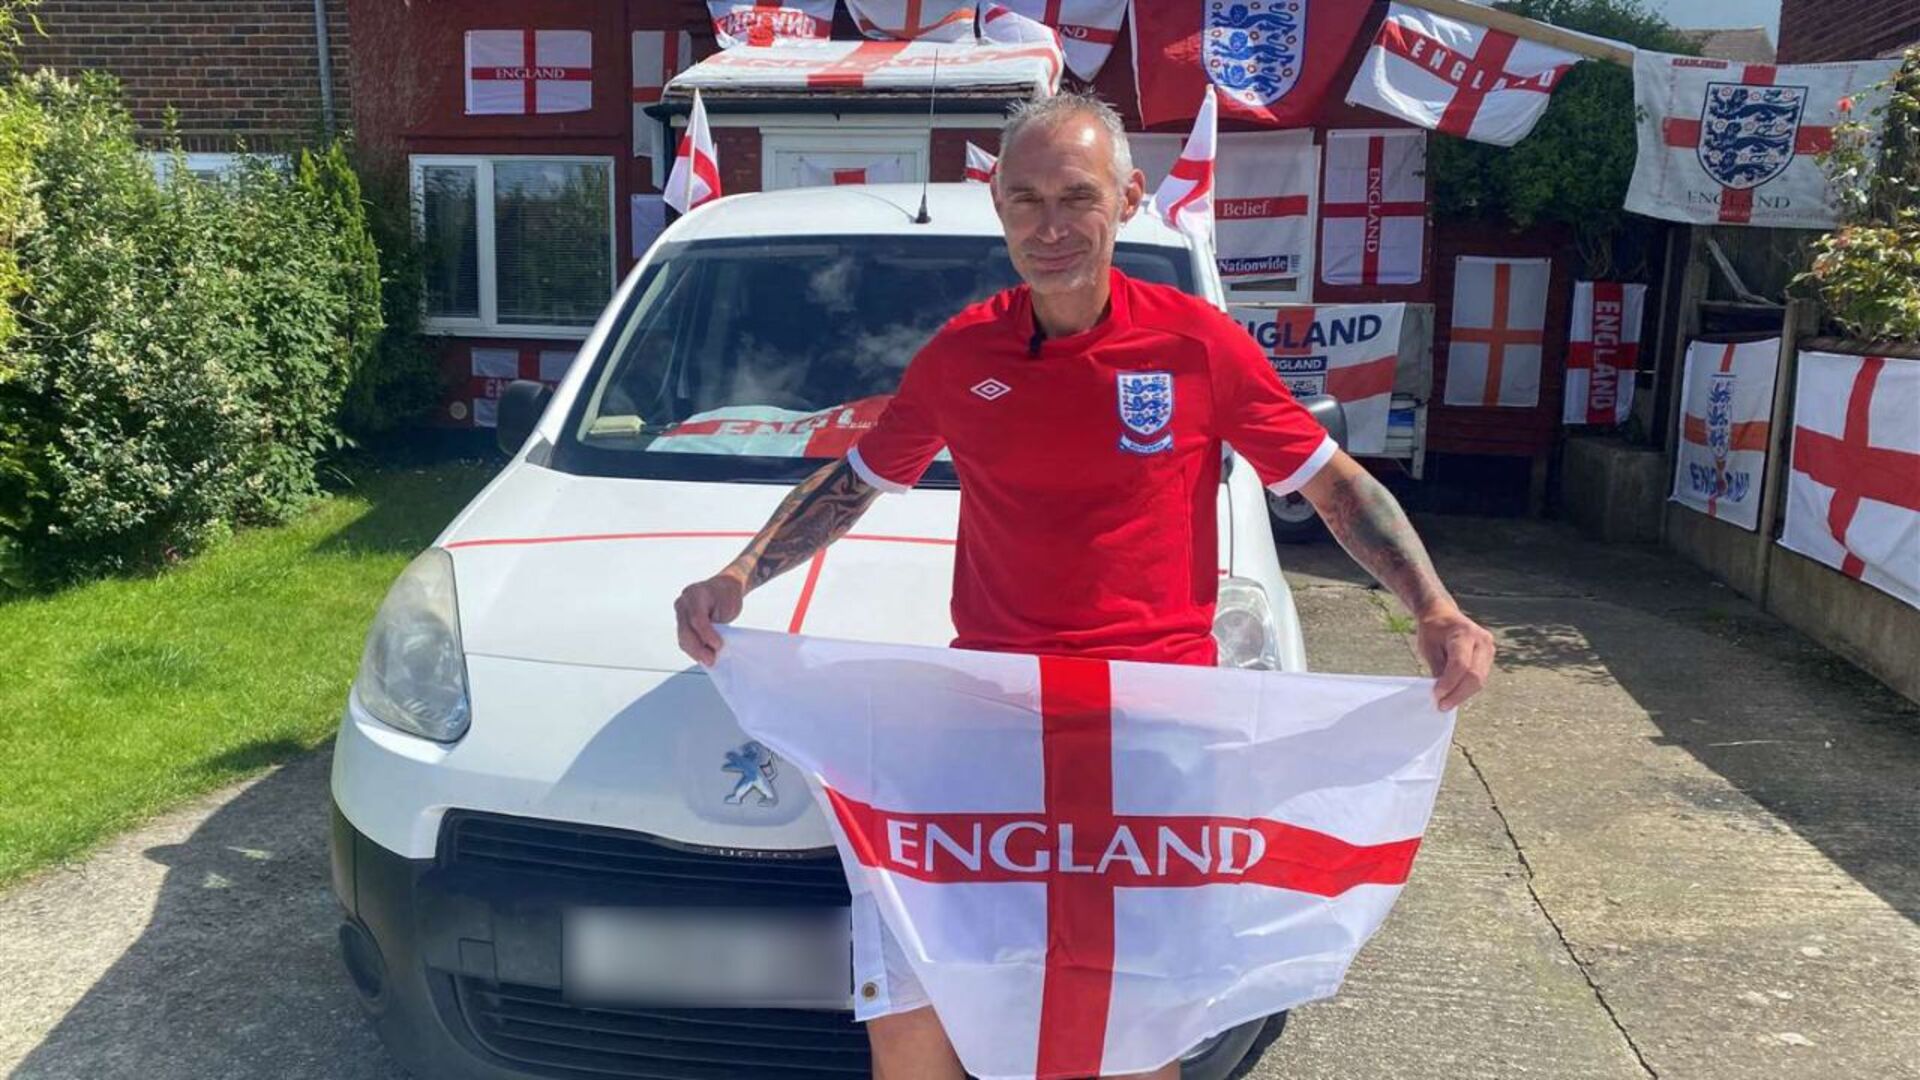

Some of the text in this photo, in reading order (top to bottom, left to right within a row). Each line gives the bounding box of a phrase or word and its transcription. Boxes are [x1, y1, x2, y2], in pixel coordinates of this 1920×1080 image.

[495, 68, 566, 80] ENGLAND
[1367, 167, 1381, 252] ENGLAND
[1218, 257, 1287, 273] Nationwide
[1272, 359, 1322, 371] NGLAND
[1591, 301, 1620, 410] ENGLAND
[887, 819, 1266, 876] ENGLAND
